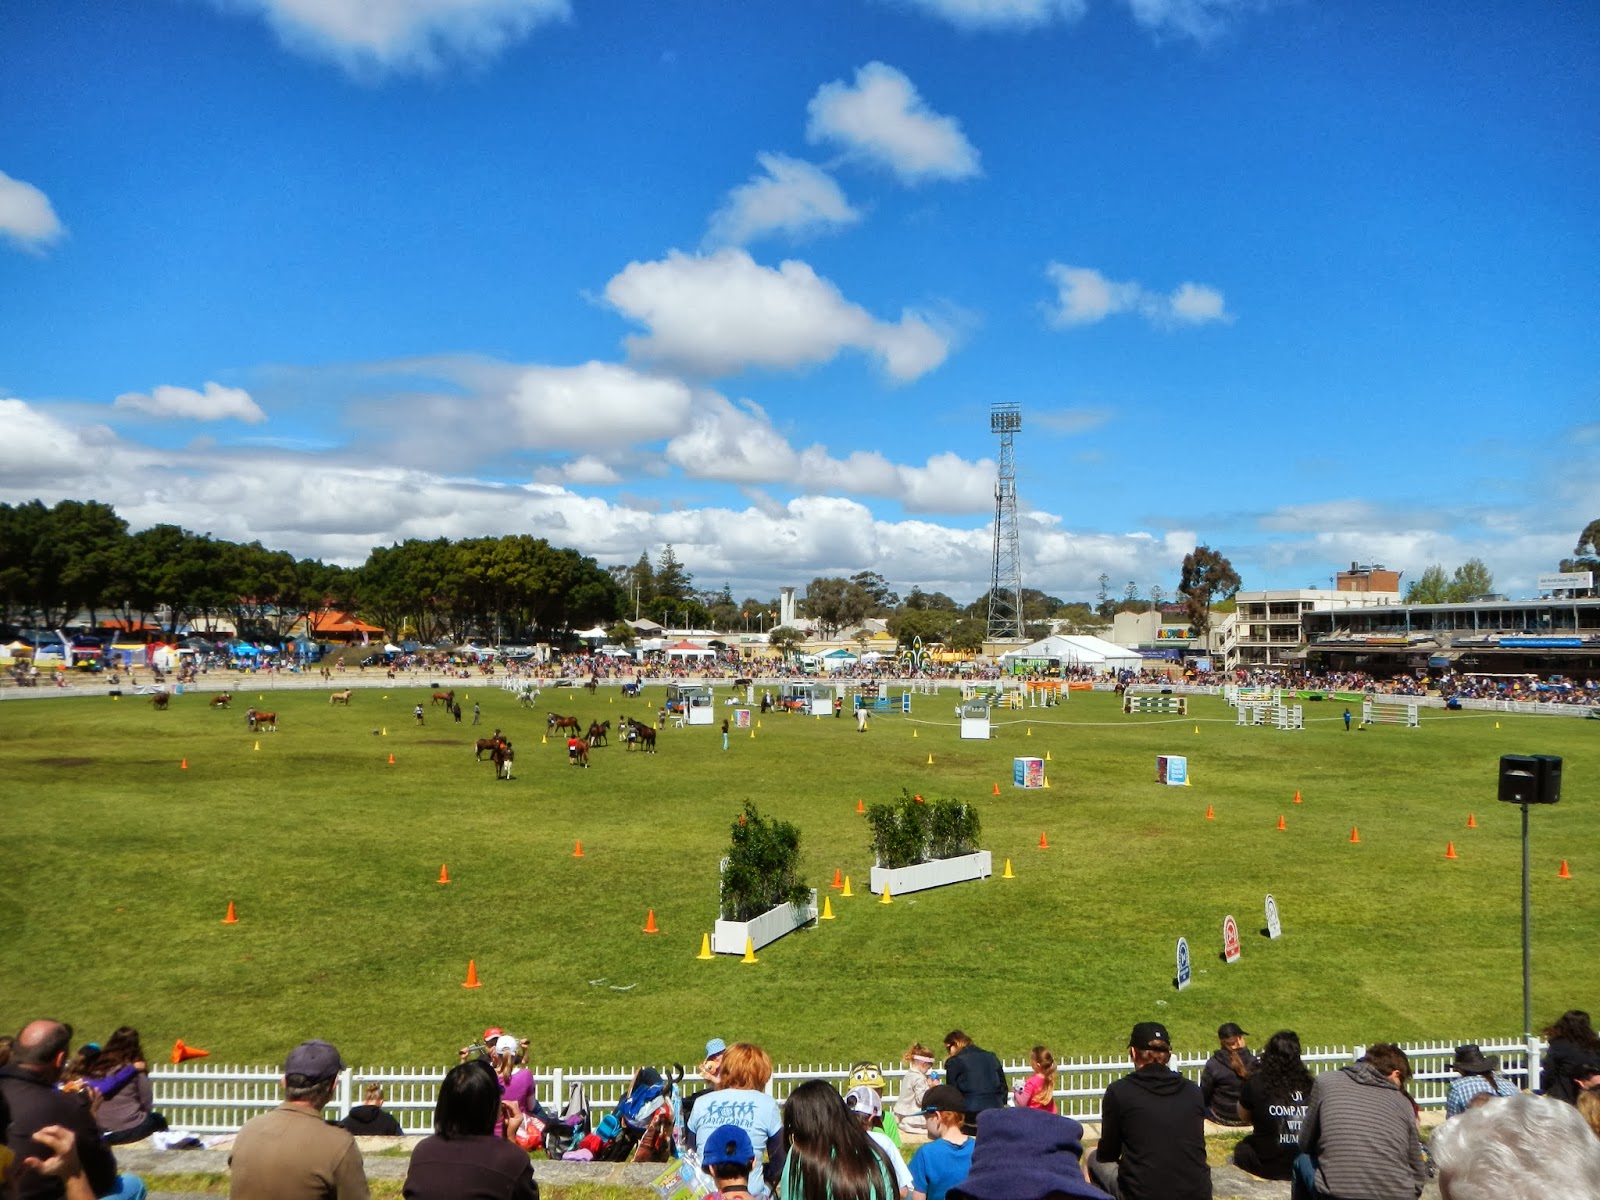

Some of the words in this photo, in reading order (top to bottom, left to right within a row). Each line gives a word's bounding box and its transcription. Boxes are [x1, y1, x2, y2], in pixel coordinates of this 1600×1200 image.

[1269, 1105, 1308, 1116] COMPAT
[1286, 1120, 1303, 1130] WIT
[1279, 1133, 1299, 1143] HUM
